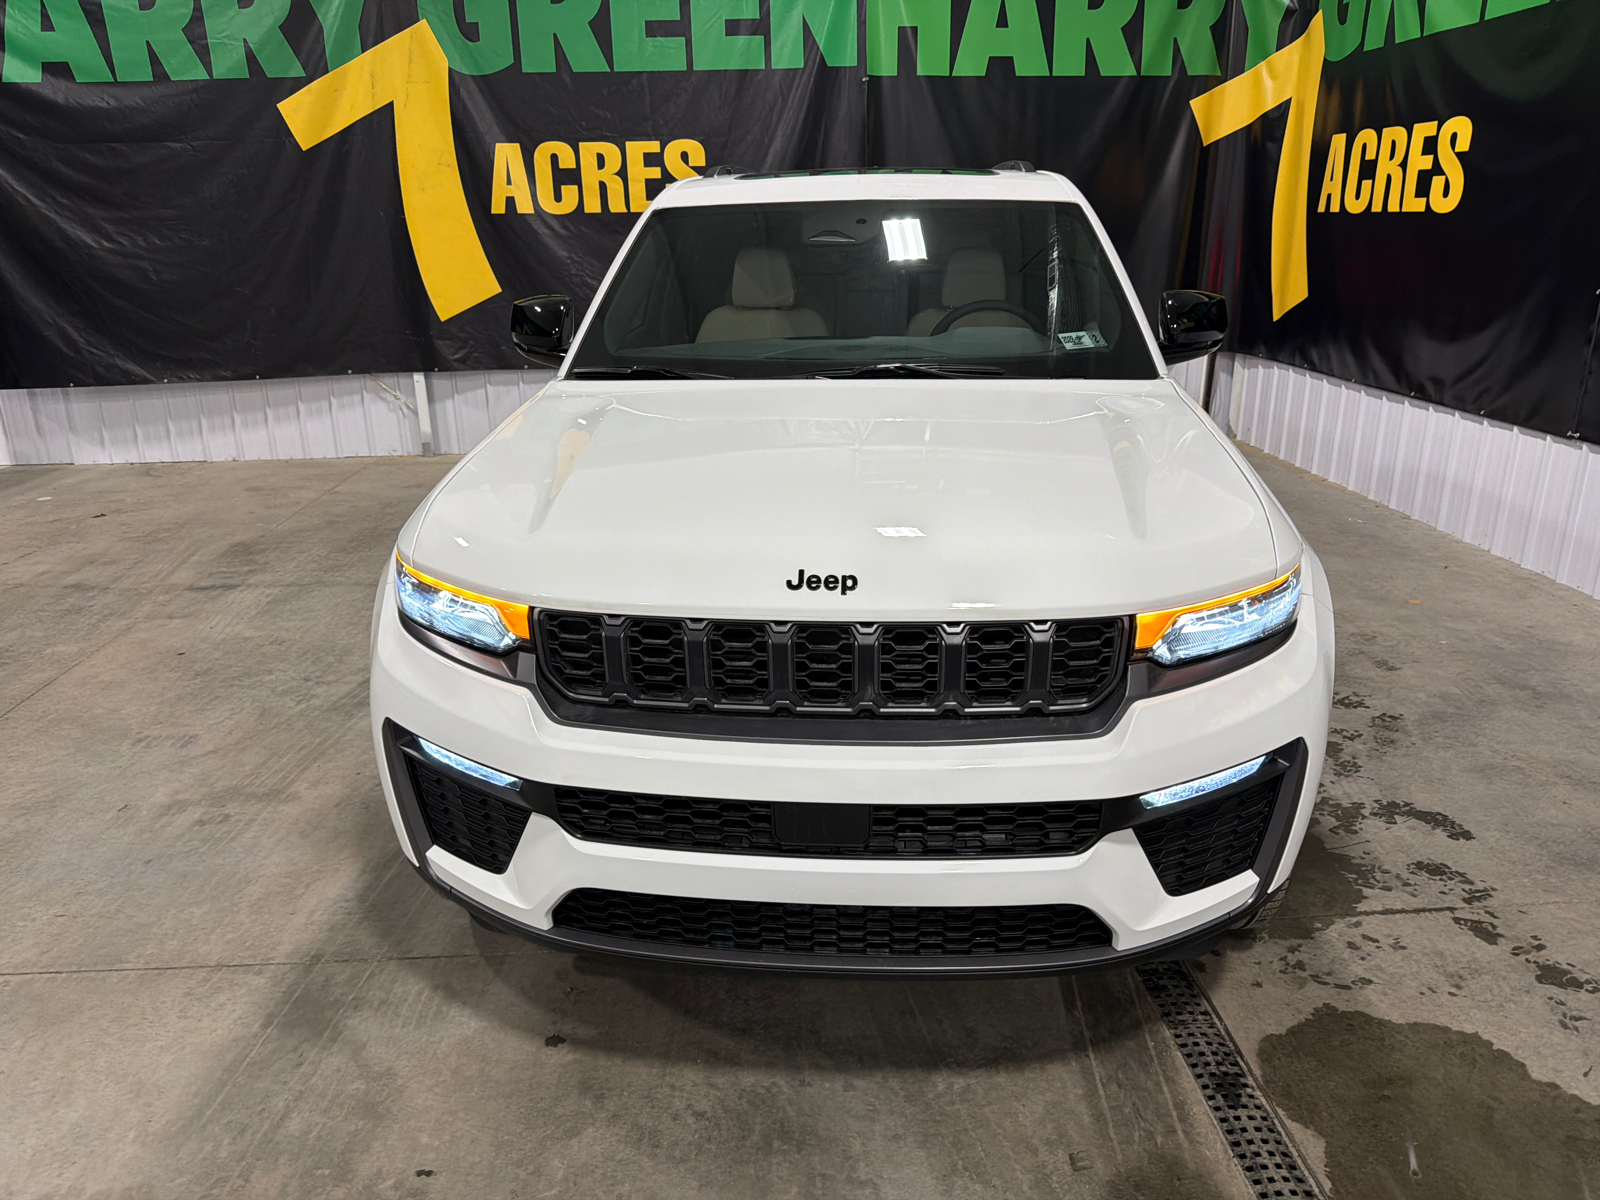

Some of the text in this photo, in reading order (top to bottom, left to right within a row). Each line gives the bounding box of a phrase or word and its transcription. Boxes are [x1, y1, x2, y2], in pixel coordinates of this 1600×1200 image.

[417, 0, 858, 76] GREEN
[865, 0, 1292, 77] HARRY
[277, 19, 501, 322] 7
[490, 138, 706, 215] ACRES
[1189, 9, 1325, 322] 7
[1317, 115, 1473, 214] ACRES
[785, 568, 858, 596] Jeep
